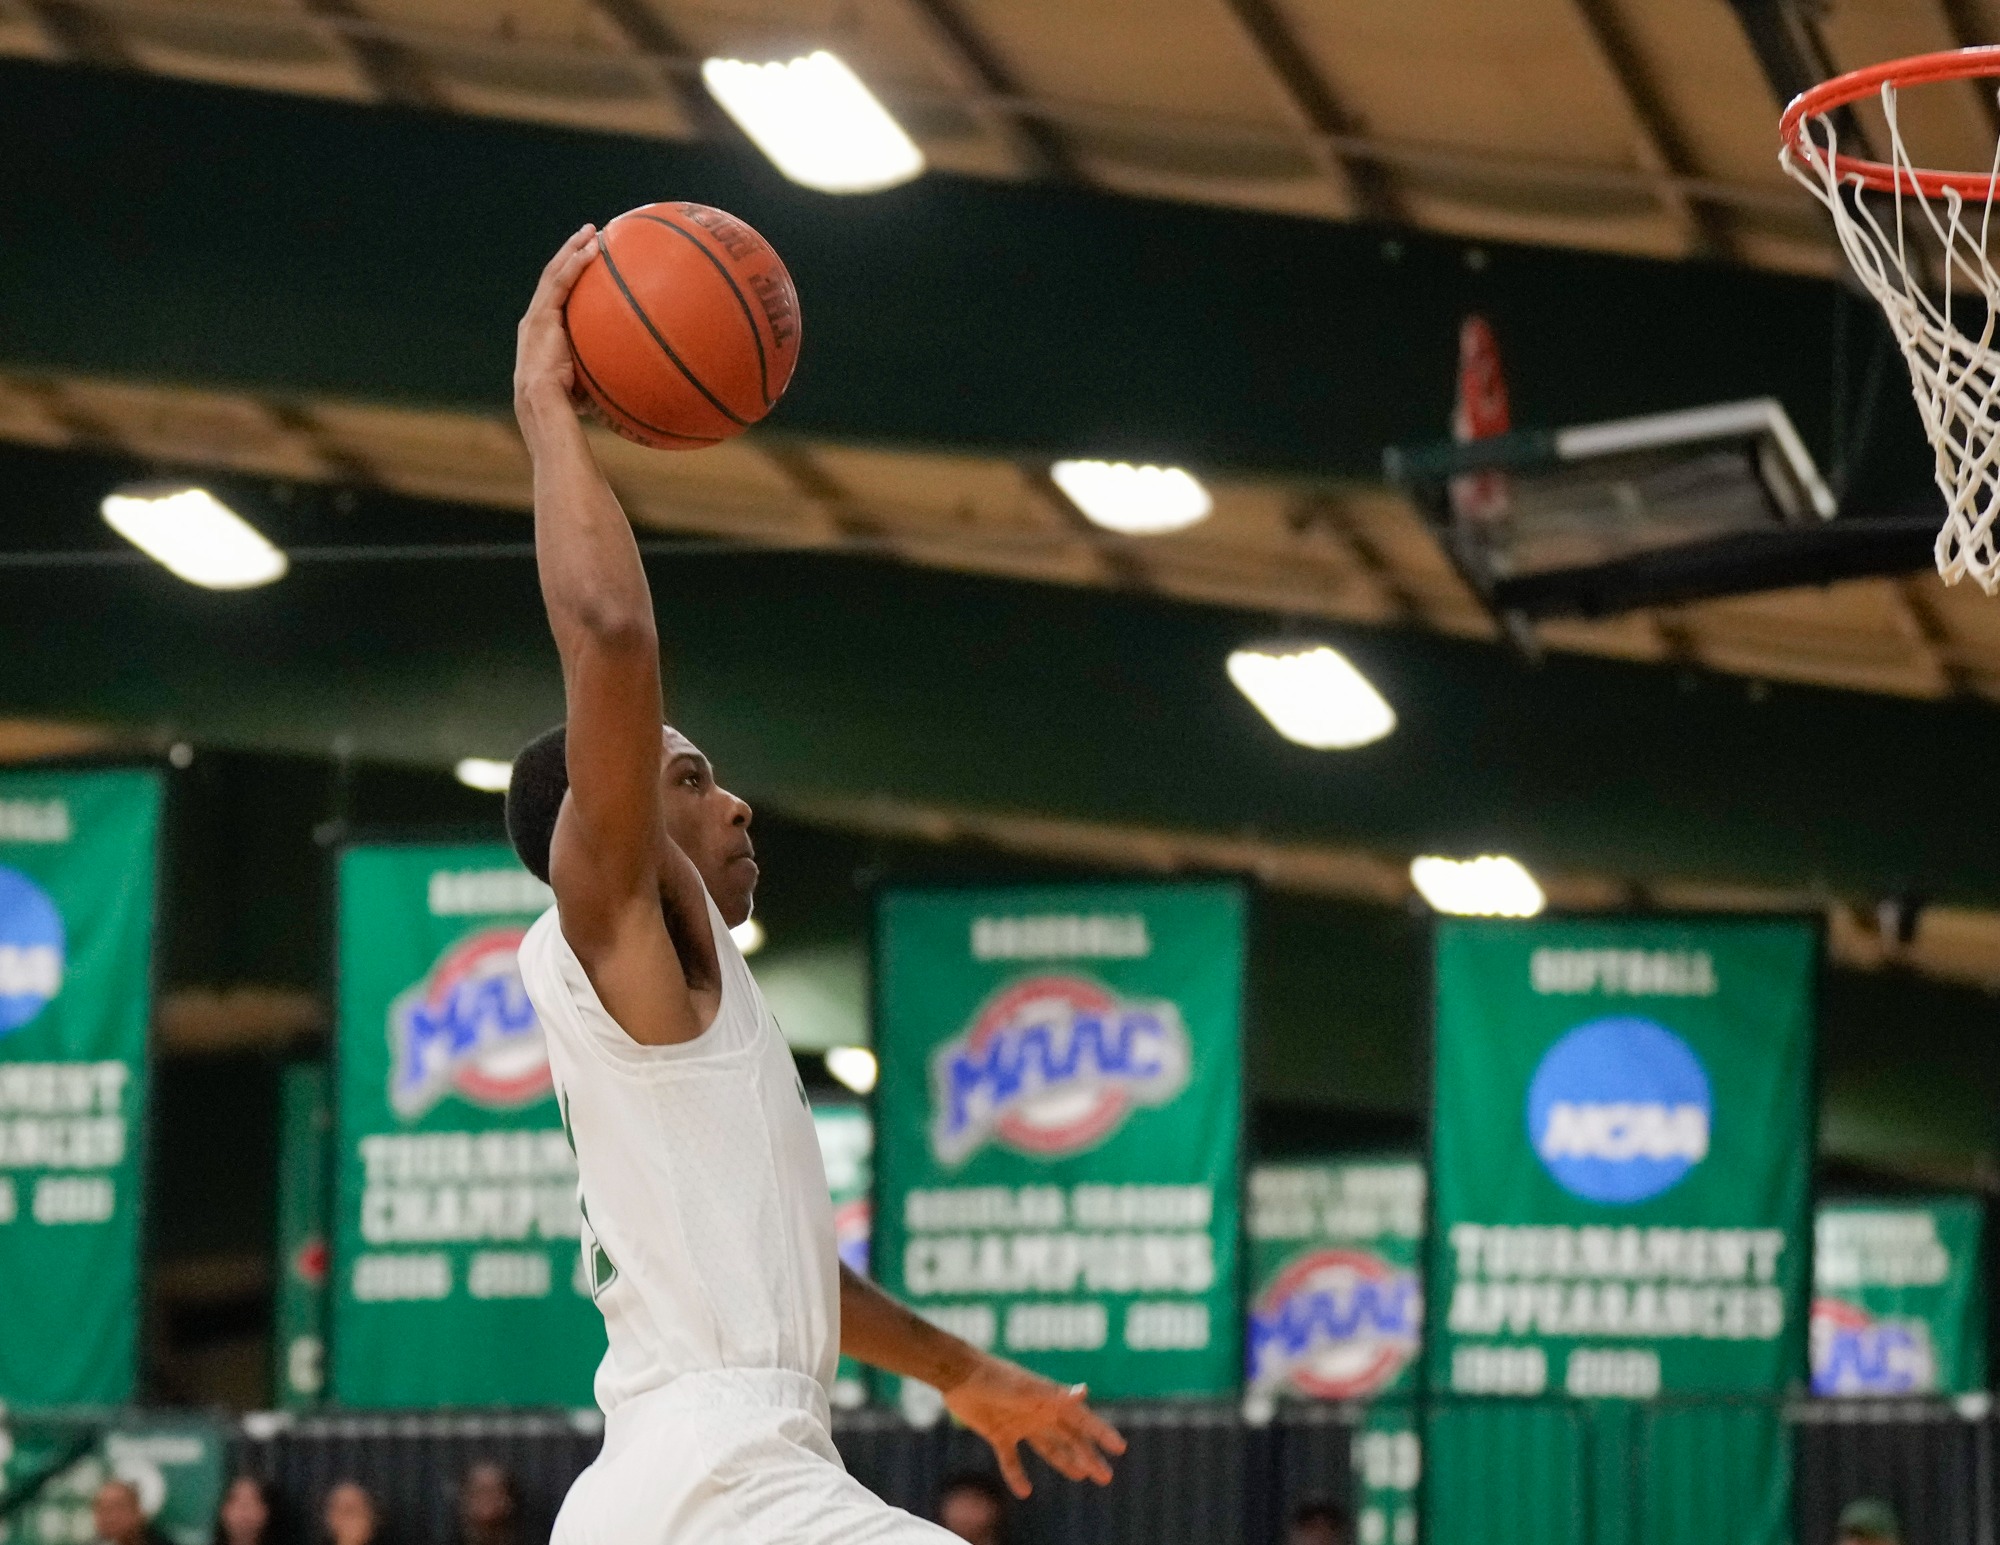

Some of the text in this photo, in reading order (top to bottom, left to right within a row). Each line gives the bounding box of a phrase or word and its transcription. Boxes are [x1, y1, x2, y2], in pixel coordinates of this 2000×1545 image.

[1531, 950, 1714, 994] SOFTBALL
[1544, 1104, 1708, 1160] NCAA
[904, 1234, 1213, 1294] CHAMPIONS
[1450, 1224, 1783, 1280] TOURNAMENT
[1449, 1281, 1783, 1338] APPEARANCES
